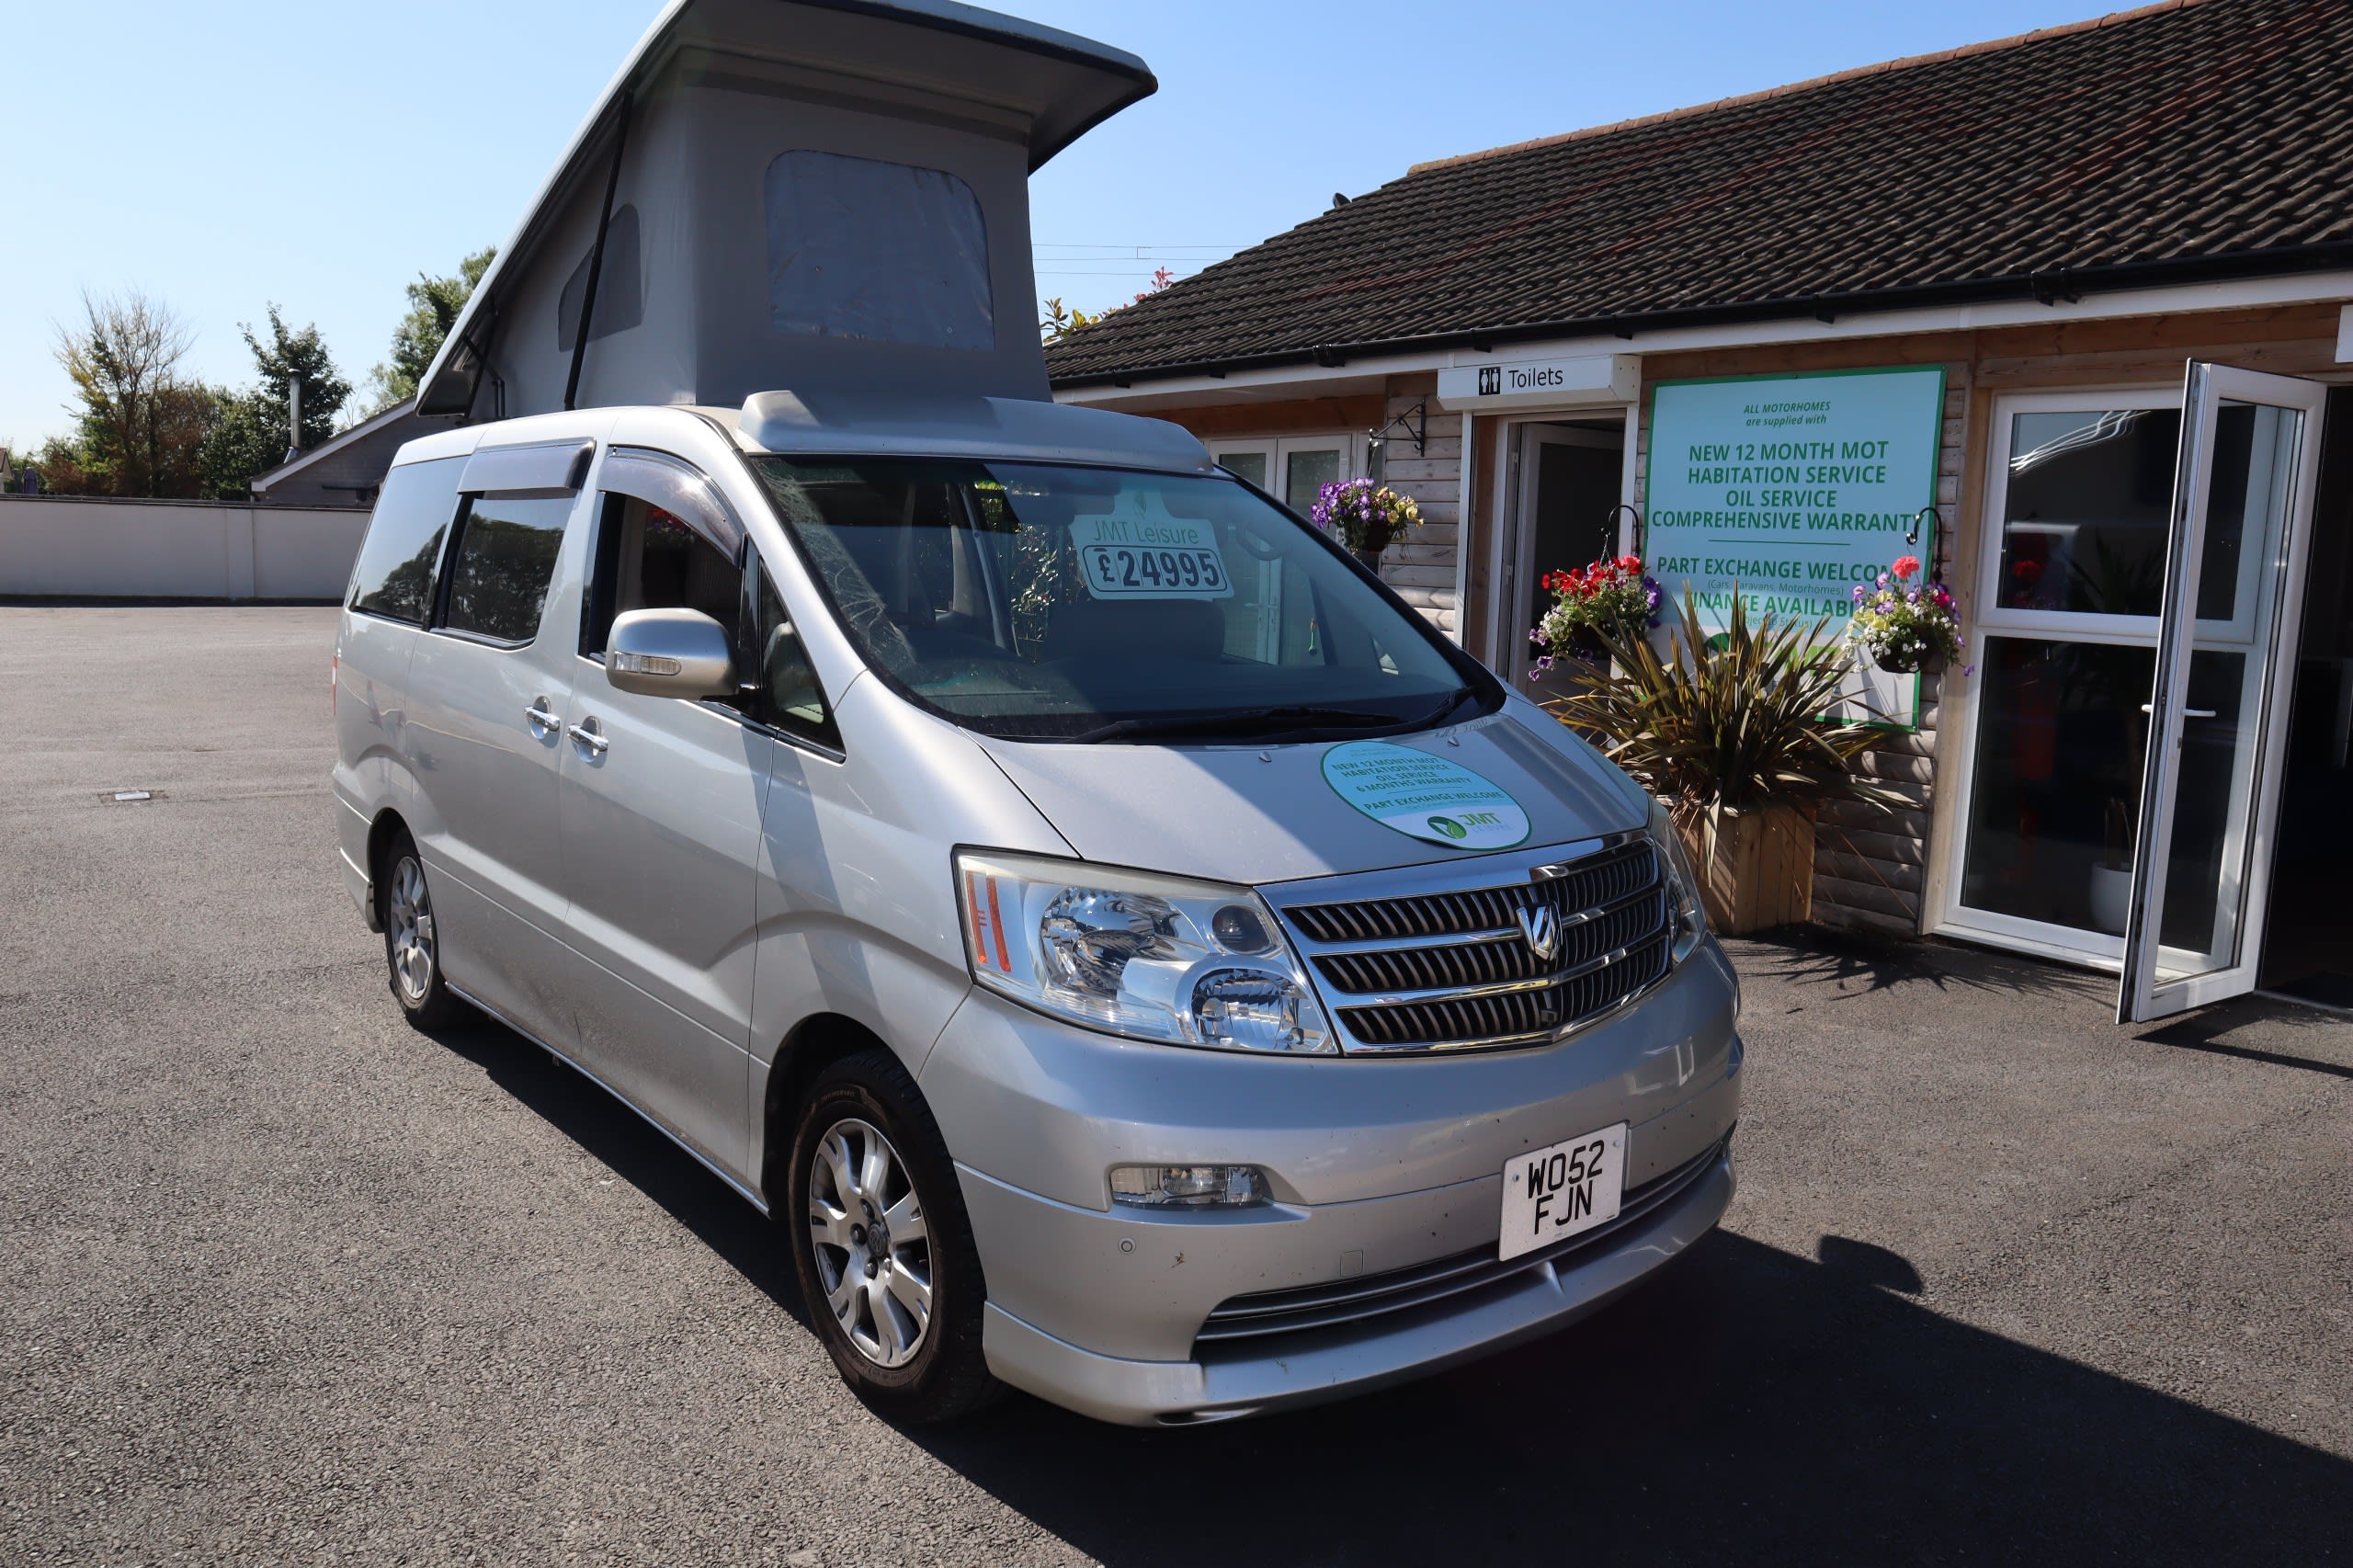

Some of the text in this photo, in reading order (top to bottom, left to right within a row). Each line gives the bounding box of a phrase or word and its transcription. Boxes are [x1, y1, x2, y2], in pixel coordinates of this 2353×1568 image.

[1508, 368, 1563, 389] Toilets
[1744, 401, 1831, 414] ALL MOTORHOMES
[1746, 415, 1827, 427] are supplied with
[1688, 440, 1890, 461] NEW 12 MONTH MOT
[1688, 465, 1886, 484] HABITATION SERVICE
[1726, 489, 1837, 508] OIL SERVICE
[1652, 510, 1925, 532] COMPREHENSIVE WARRANTY
[1093, 519, 1199, 544] JMT Leisure
[1657, 556, 1700, 574] PART
[1704, 558, 1802, 579] EXCHANGE
[1732, 580, 1776, 593] aravans,
[1779, 582, 1845, 597] Motorhomes)
[1685, 589, 1866, 619] INANCE AVAILABI
[1331, 761, 1358, 771] NEW
[1360, 759, 1375, 767] 12
[1374, 757, 1413, 767] MONTH
[1341, 765, 1407, 778] HABITATION
[1365, 779, 1414, 791] MONTHS
[1415, 777, 1472, 786] WARRANTY
[1376, 771, 1439, 782] OIL SERVICE
[1364, 798, 1395, 811] PART
[1395, 793, 1452, 807] EXCHANGE
[1453, 790, 1505, 801] WELCOME
[1458, 812, 1503, 827] JMT
[1528, 1139, 1605, 1199] WO52
[1534, 1179, 1594, 1235] FJN
